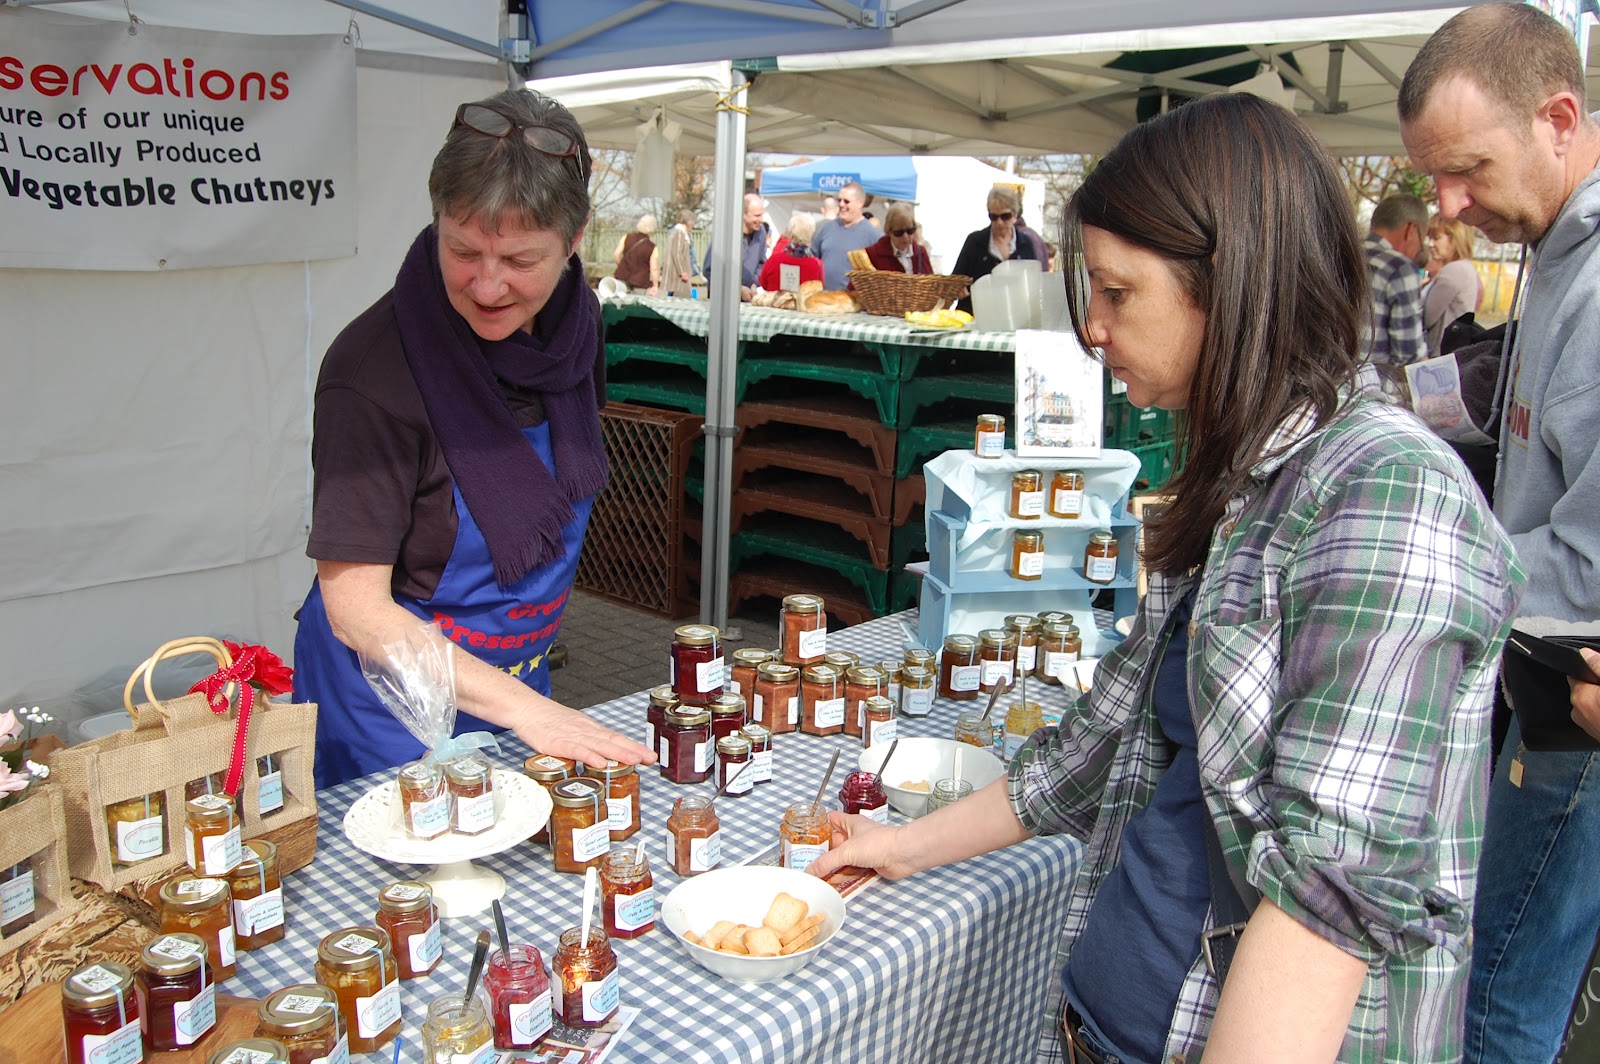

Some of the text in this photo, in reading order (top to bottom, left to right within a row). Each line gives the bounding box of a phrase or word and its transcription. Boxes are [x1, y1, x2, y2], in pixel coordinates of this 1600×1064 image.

[0, 57, 289, 101] servations
[0, 106, 245, 135] ure of our unique
[18, 136, 121, 167] Locally
[136, 140, 262, 163] Produced
[0, 166, 335, 210] Vegetable Chutneys
[1507, 402, 1531, 440] ON
